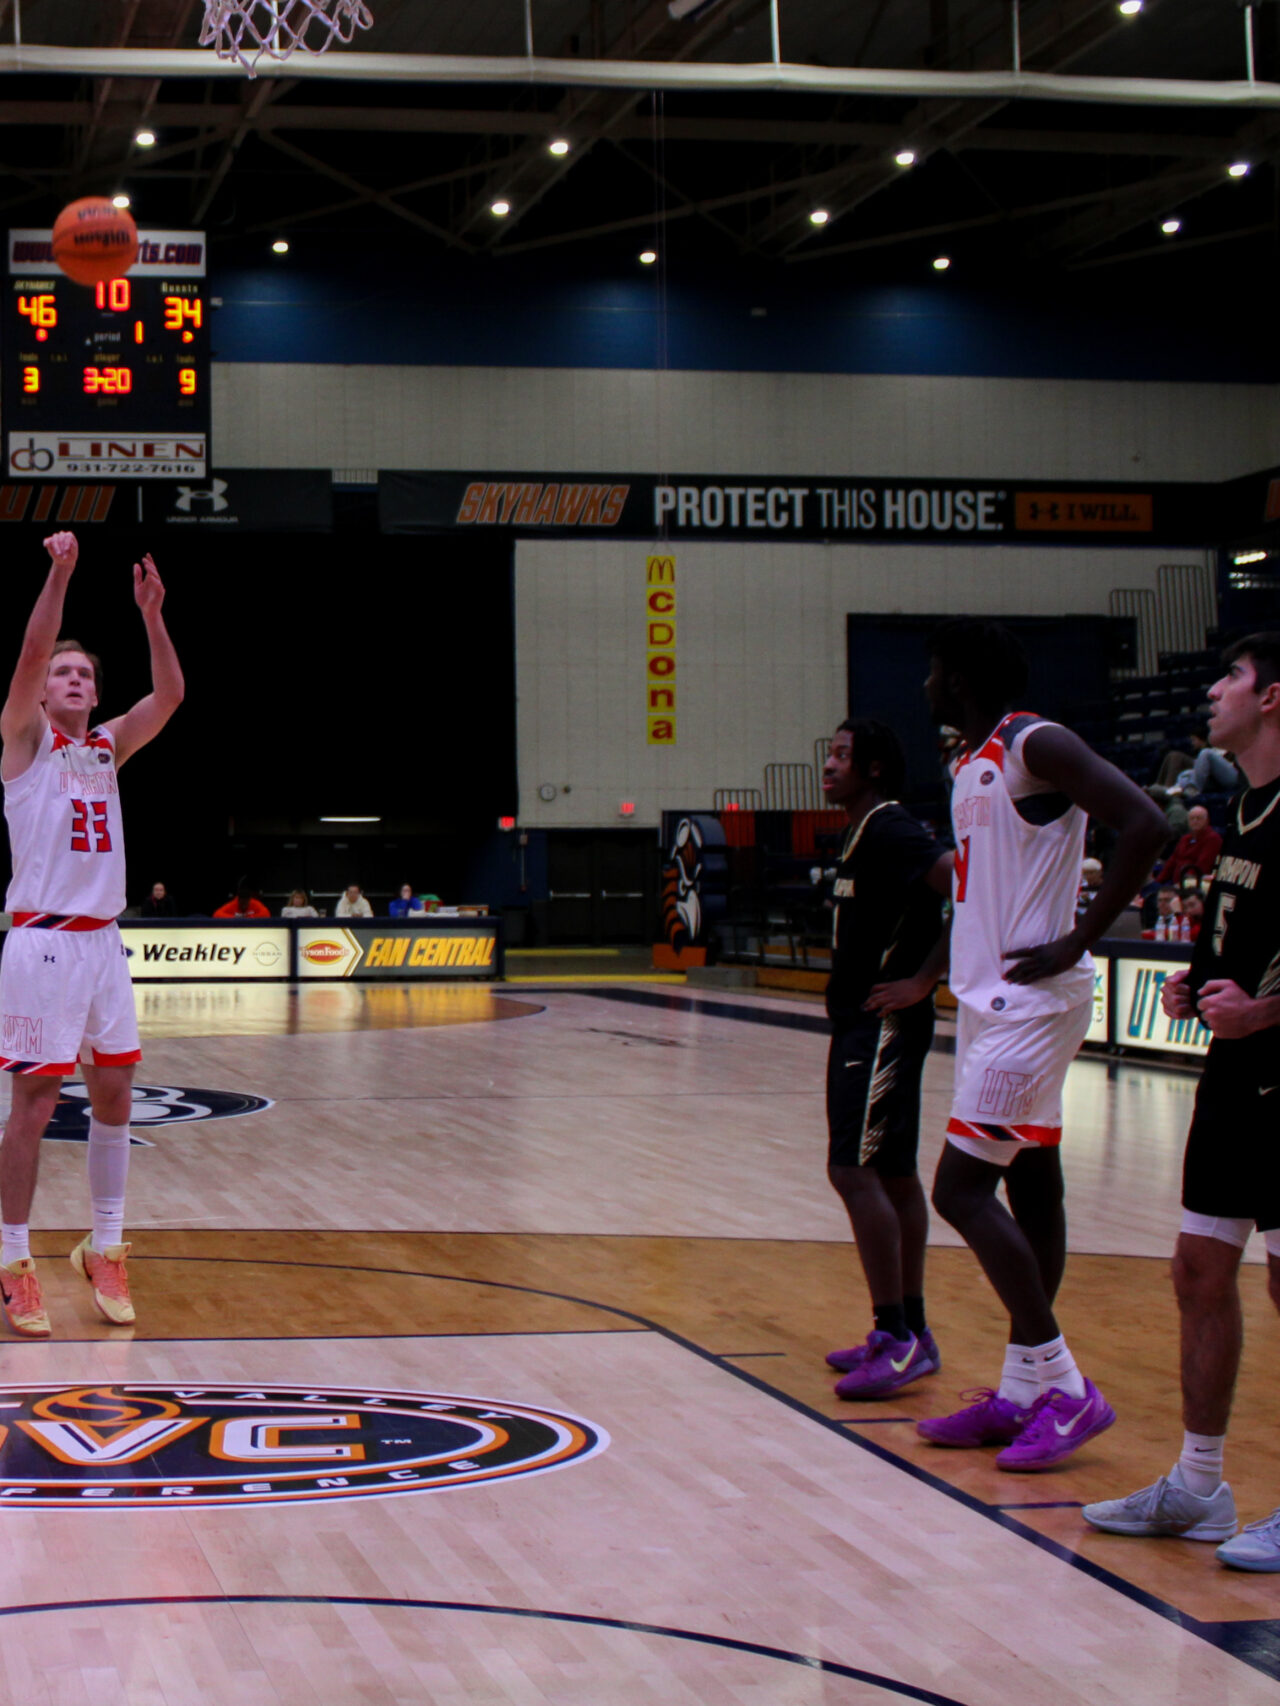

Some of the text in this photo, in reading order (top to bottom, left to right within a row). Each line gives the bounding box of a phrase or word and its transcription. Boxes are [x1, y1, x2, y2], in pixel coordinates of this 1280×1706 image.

[95, 278, 131, 312] 10
[18, 295, 58, 328] 46
[164, 296, 203, 330] 34
[135, 320, 144, 344] 1
[23, 366, 40, 393] 3
[83, 366, 132, 394] 3-20
[178, 368, 196, 395] 9
[58, 442, 204, 458] LINEN
[456, 482, 631, 526] SKYHAWKS
[654, 486, 809, 528] PROTECT
[816, 488, 876, 529] THIS
[70, 798, 113, 853] 33
[142, 943, 247, 964] Weakley
[364, 936, 496, 967] FAN CENTRAL
[2, 1014, 43, 1055] UTM
[173, 1391, 513, 1420] VALLEY
